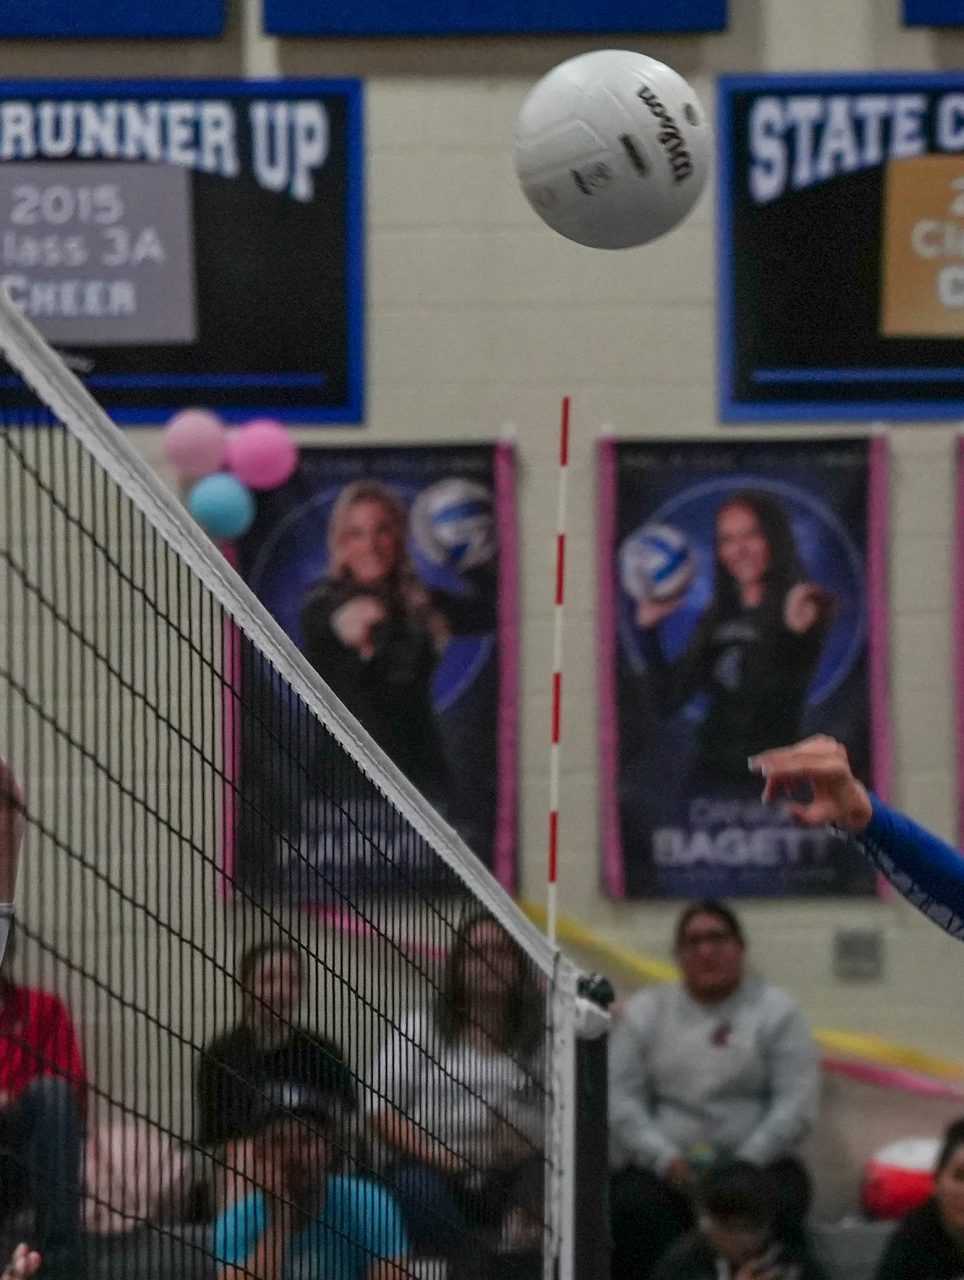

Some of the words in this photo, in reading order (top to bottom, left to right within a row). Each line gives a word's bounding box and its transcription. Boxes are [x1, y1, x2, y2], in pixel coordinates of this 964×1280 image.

[0, 100, 241, 178] RUNNER
[250, 101, 329, 201] UP
[749, 94, 928, 202] STATE
[9, 184, 124, 225] 2015
[1, 229, 89, 267] lass
[100, 226, 168, 267] 3A
